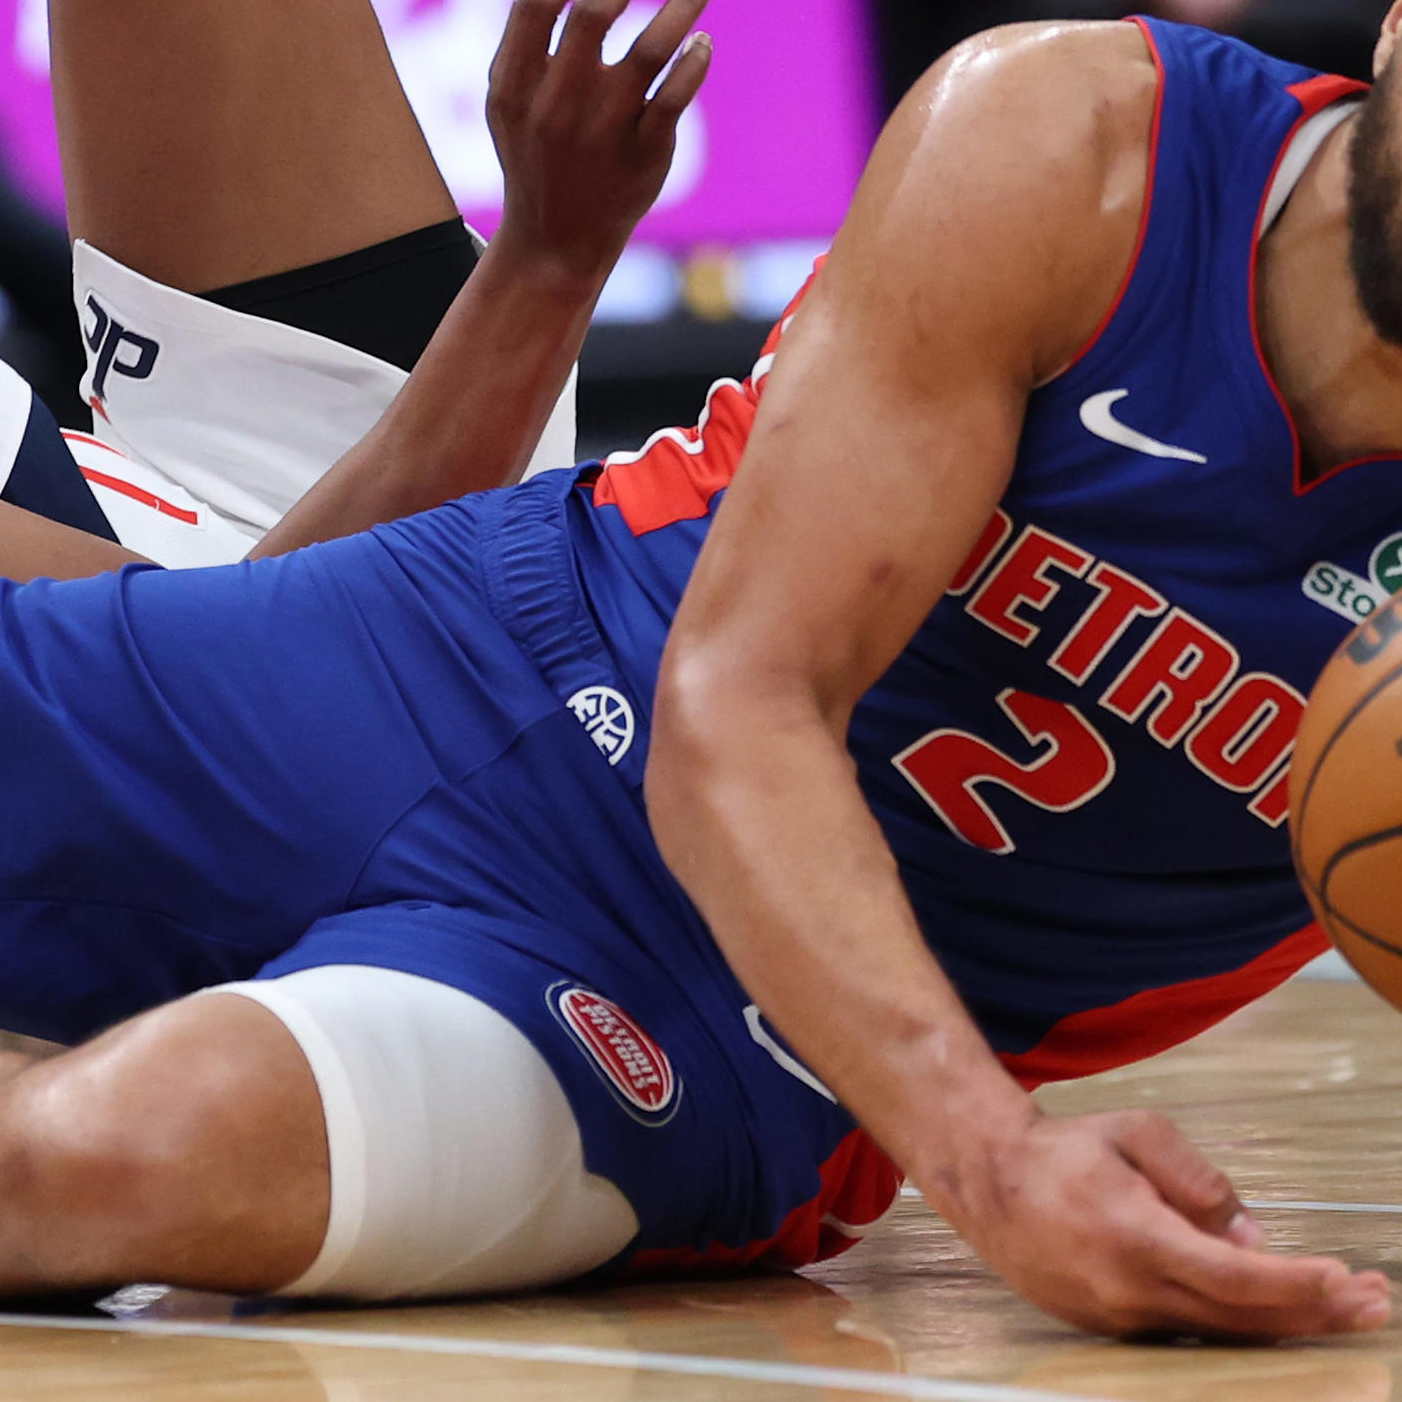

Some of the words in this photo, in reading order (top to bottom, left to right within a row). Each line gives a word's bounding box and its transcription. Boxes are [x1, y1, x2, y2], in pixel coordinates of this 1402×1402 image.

[1309, 565, 1377, 618] Sto
[942, 506, 1306, 828] ETRO
[891, 687, 1115, 855] 2
[579, 1004, 647, 1089] PISTONS
[592, 1003, 661, 1087] DETROIT
